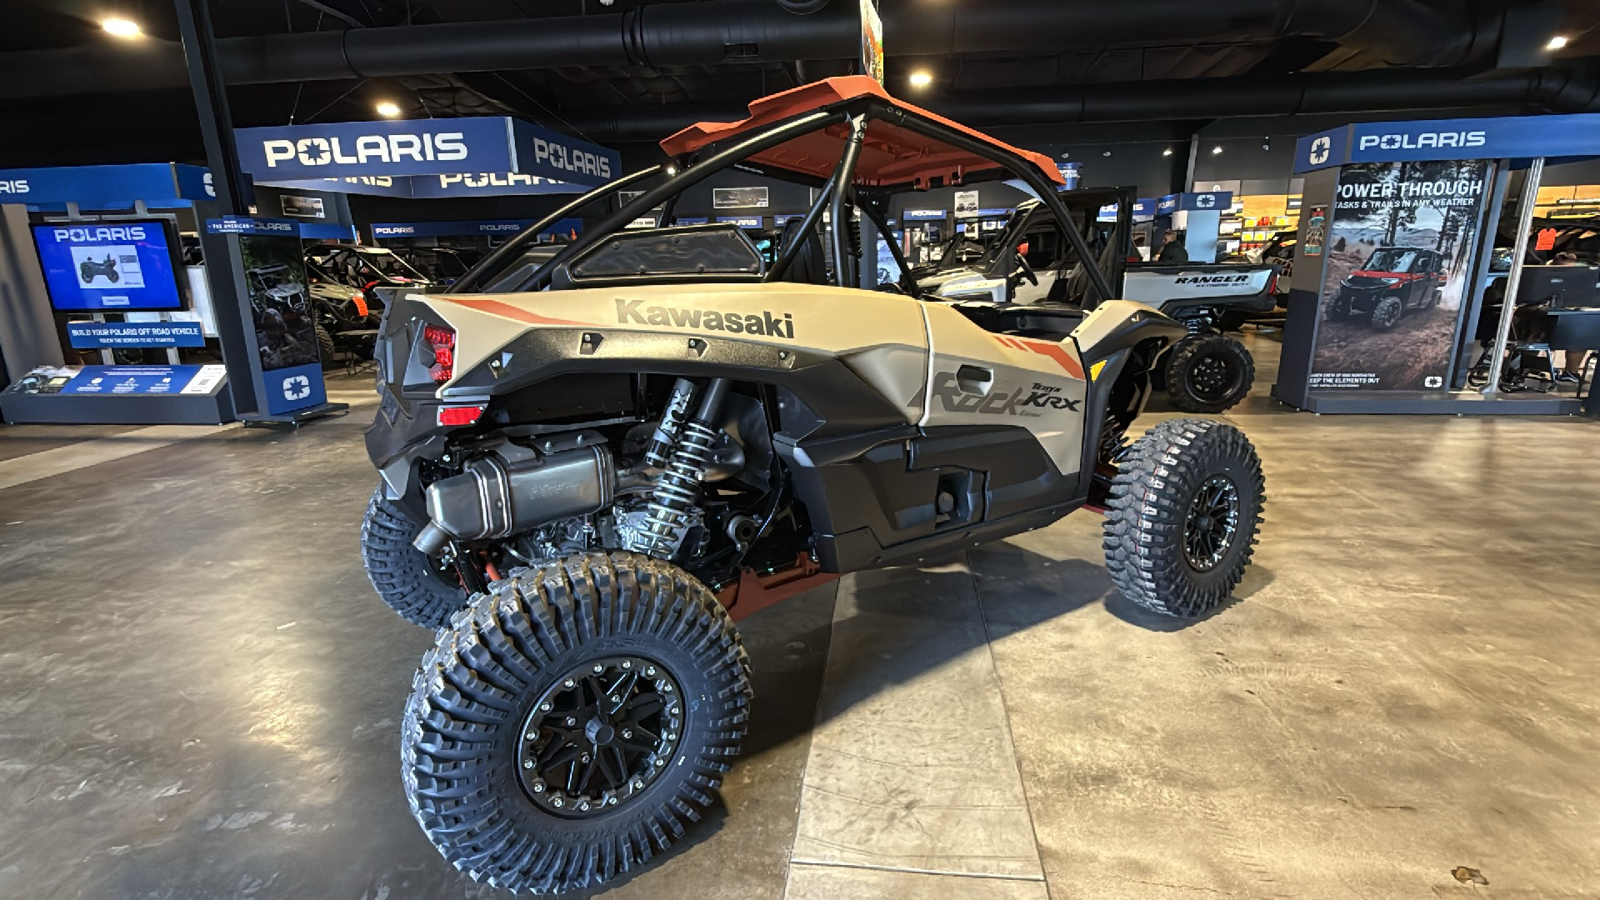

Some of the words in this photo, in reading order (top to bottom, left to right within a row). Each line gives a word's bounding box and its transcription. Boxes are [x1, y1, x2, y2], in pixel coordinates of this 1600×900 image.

[1359, 131, 1486, 151] POLARIS
[263, 132, 468, 169] POLARIS
[533, 137, 612, 179] POLARIS
[1400, 179, 1483, 197] THROUGH
[1361, 201, 1368, 209] &
[1370, 200, 1400, 209] TRAILS
[1401, 200, 1411, 208] IN
[1412, 199, 1431, 207] ANY
[1433, 198, 1475, 207] WEATHER
[54, 226, 147, 242] POLARIS
[254, 221, 292, 231] OLARIS
[375, 226, 415, 235] POLARIS
[479, 224, 520, 232] POLARIS
[1175, 275, 1249, 285] RANGER
[615, 298, 795, 339] Kawasaki
[151, 327, 171, 335] ROAD
[171, 327, 199, 335] VEHICLE
[1021, 391, 1083, 413] KRX
